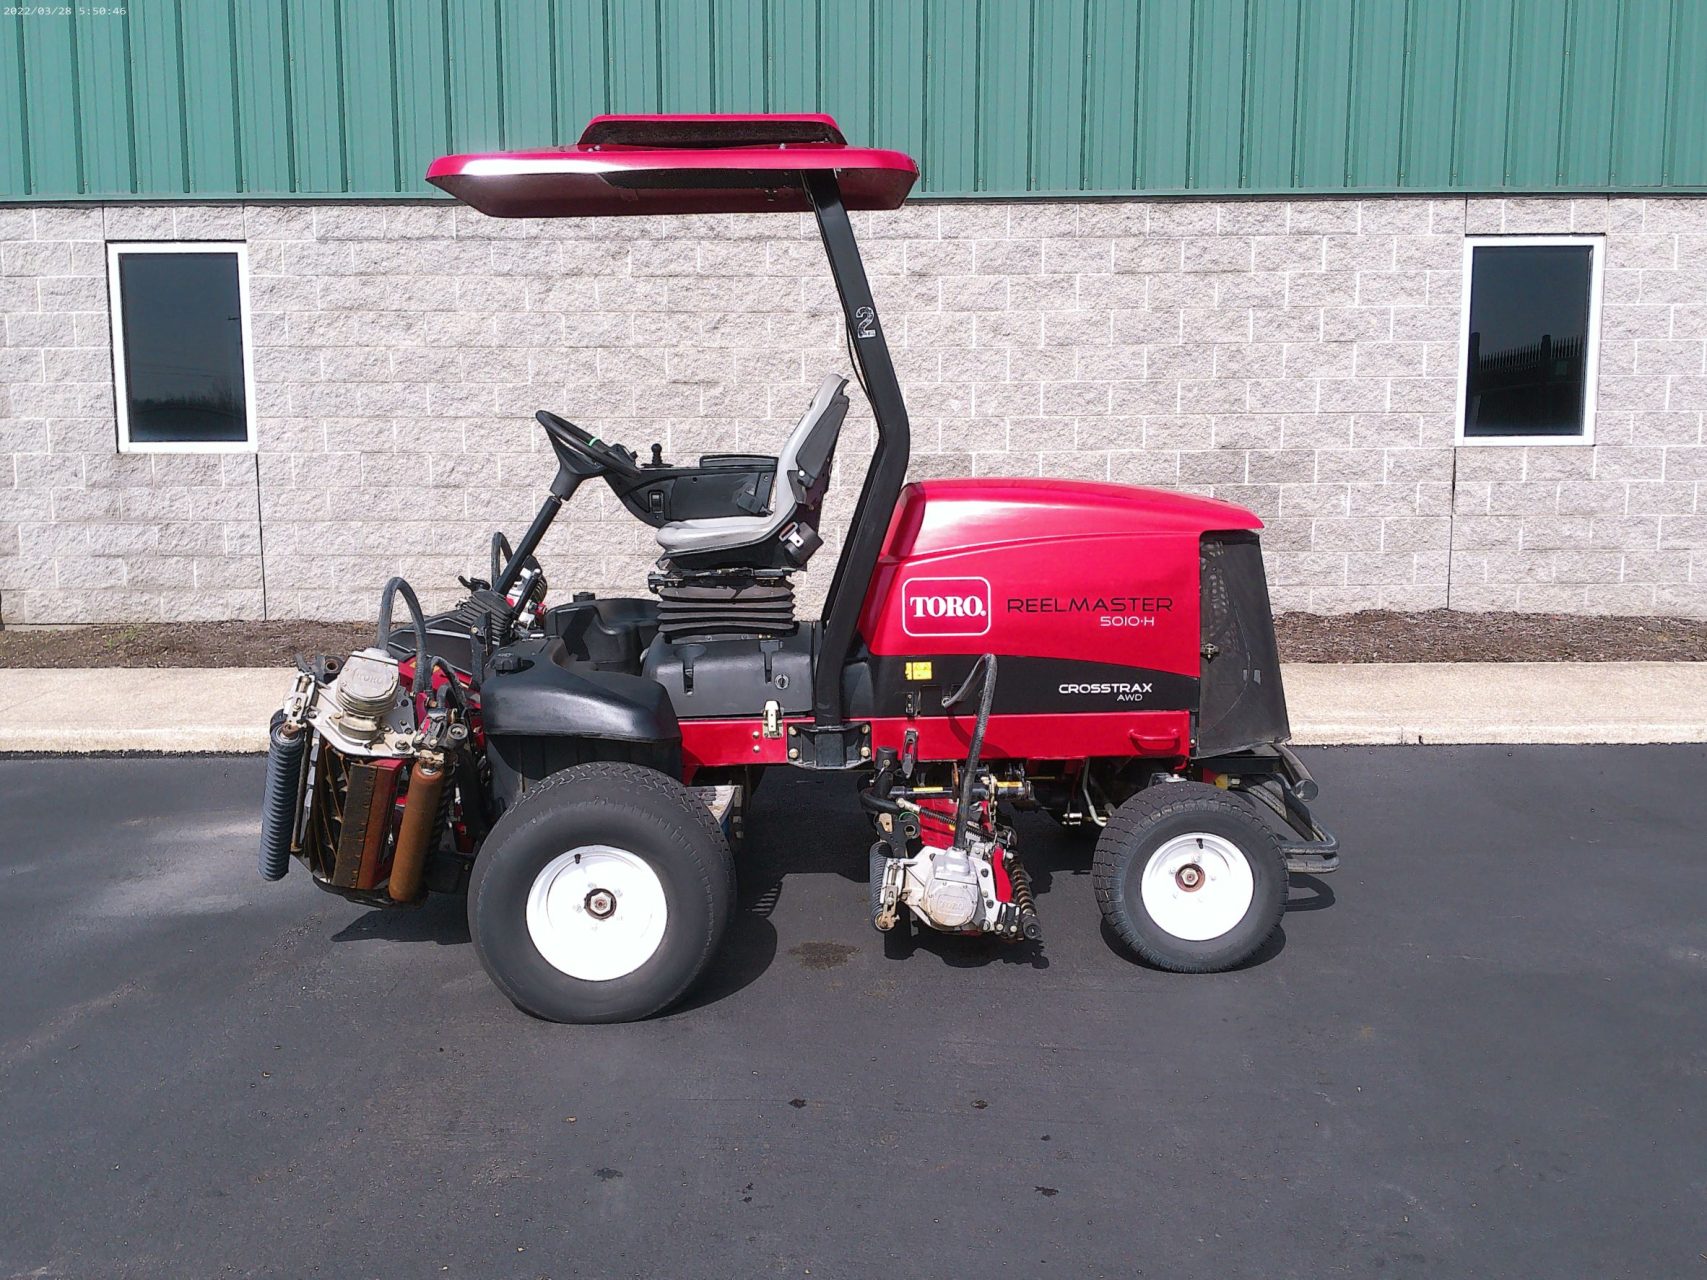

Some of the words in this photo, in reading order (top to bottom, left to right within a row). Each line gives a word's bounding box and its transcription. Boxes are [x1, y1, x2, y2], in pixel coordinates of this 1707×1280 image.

[855, 306, 876, 339] 2
[1007, 597, 1173, 613] REELMASTER
[1058, 683, 1153, 694] CROSSTRAX
[1116, 693, 1143, 702] AWD
